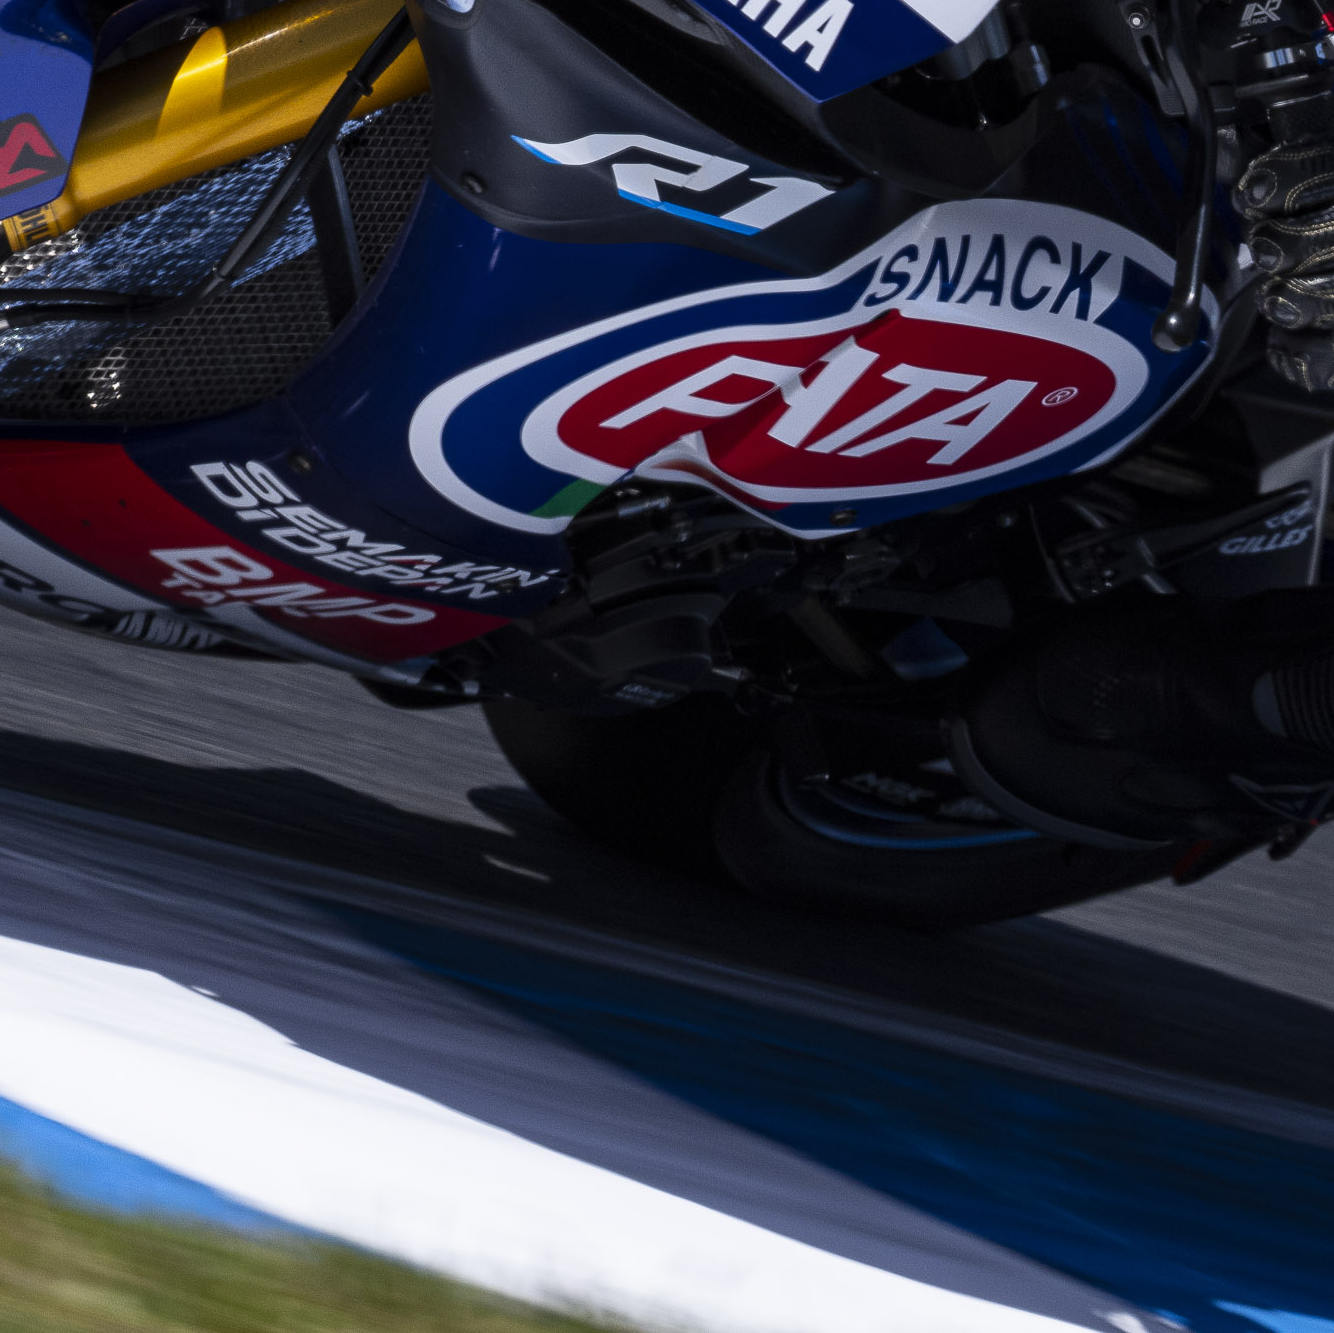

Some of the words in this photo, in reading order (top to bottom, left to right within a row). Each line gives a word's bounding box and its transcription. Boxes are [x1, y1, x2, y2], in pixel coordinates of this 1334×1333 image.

[510, 132, 837, 235] R1
[870, 234, 1115, 320] SNACK
[598, 335, 1038, 465] PATA
[150, 545, 438, 626] BMP
